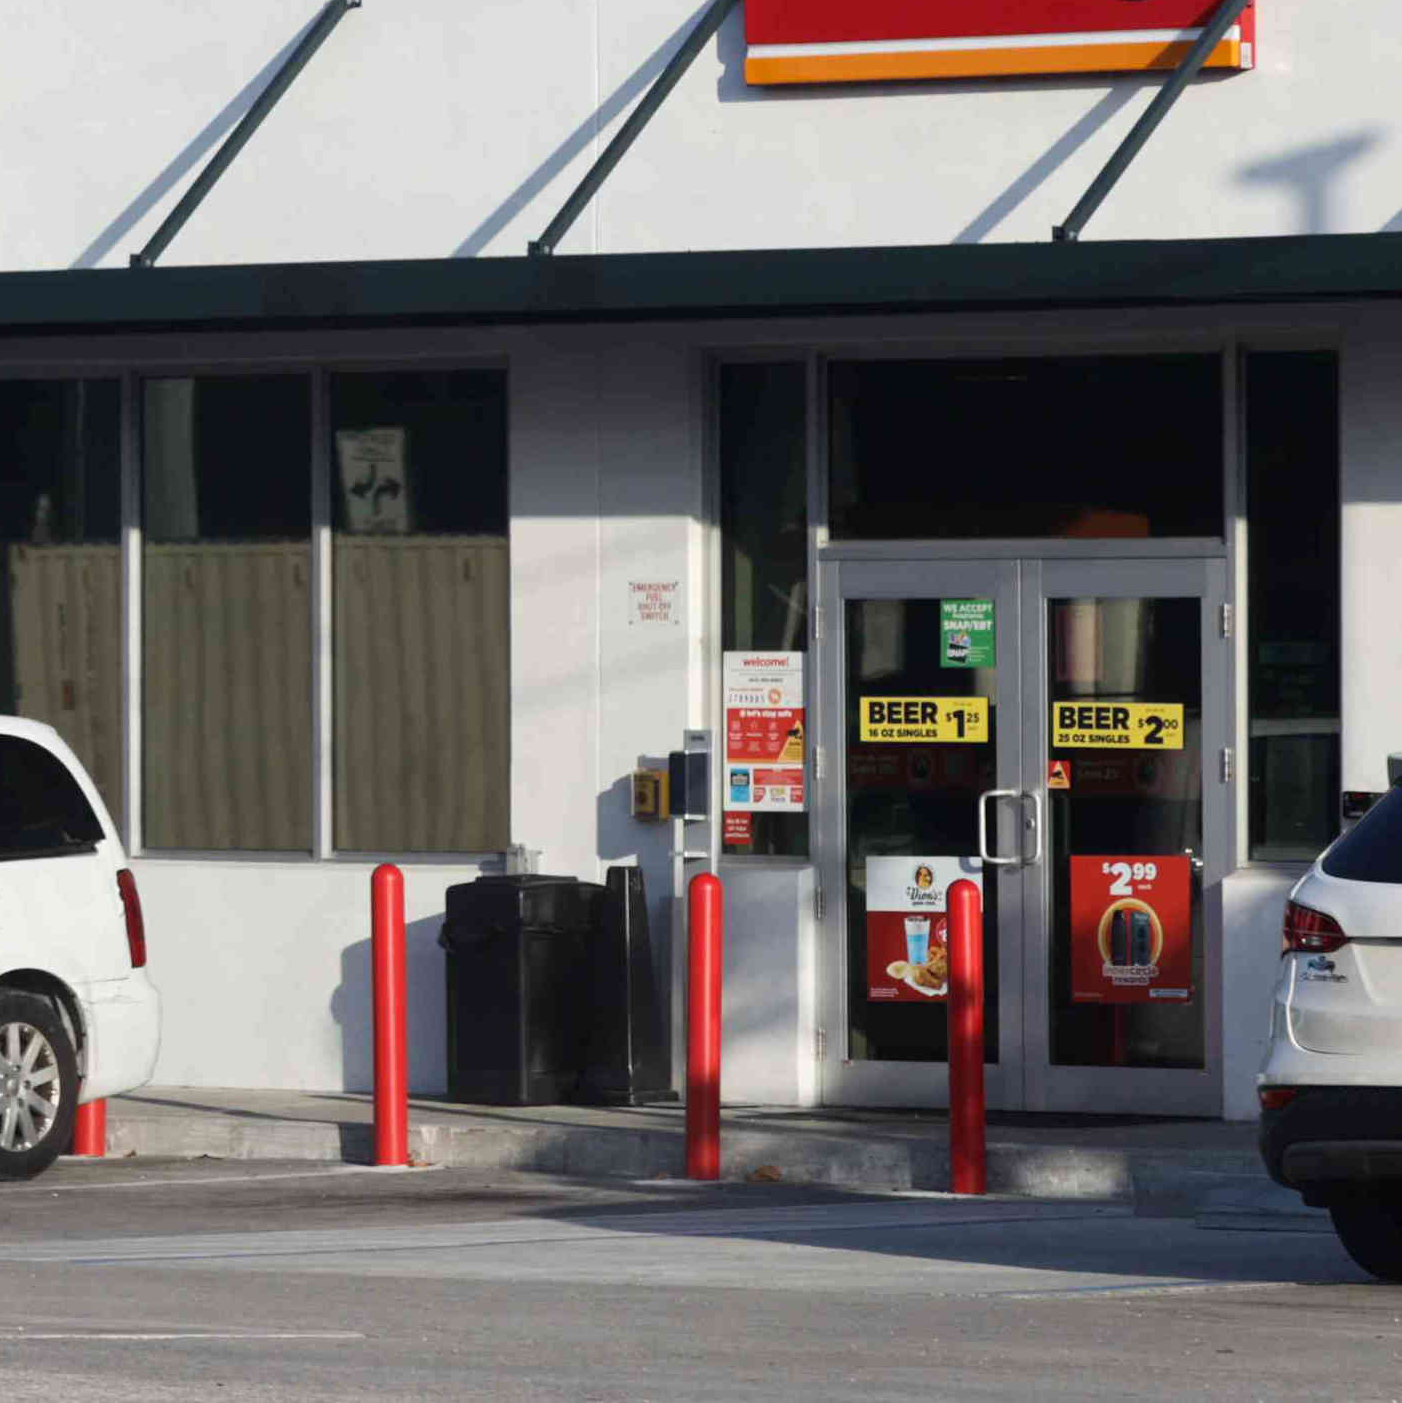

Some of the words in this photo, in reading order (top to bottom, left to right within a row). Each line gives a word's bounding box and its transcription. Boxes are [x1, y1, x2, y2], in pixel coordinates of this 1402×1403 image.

[959, 604, 993, 612] ACCEPT
[943, 621, 993, 631] SNAP/EBT
[869, 701, 938, 724] BEER
[1059, 706, 1130, 730] BEER
[869, 729, 879, 738] 16
[881, 729, 895, 738] OZ
[897, 728, 938, 738] SINGLES
[1058, 734, 1070, 743] 25
[1072, 734, 1086, 743] OZ
[1089, 734, 1130, 744] SINGLES
